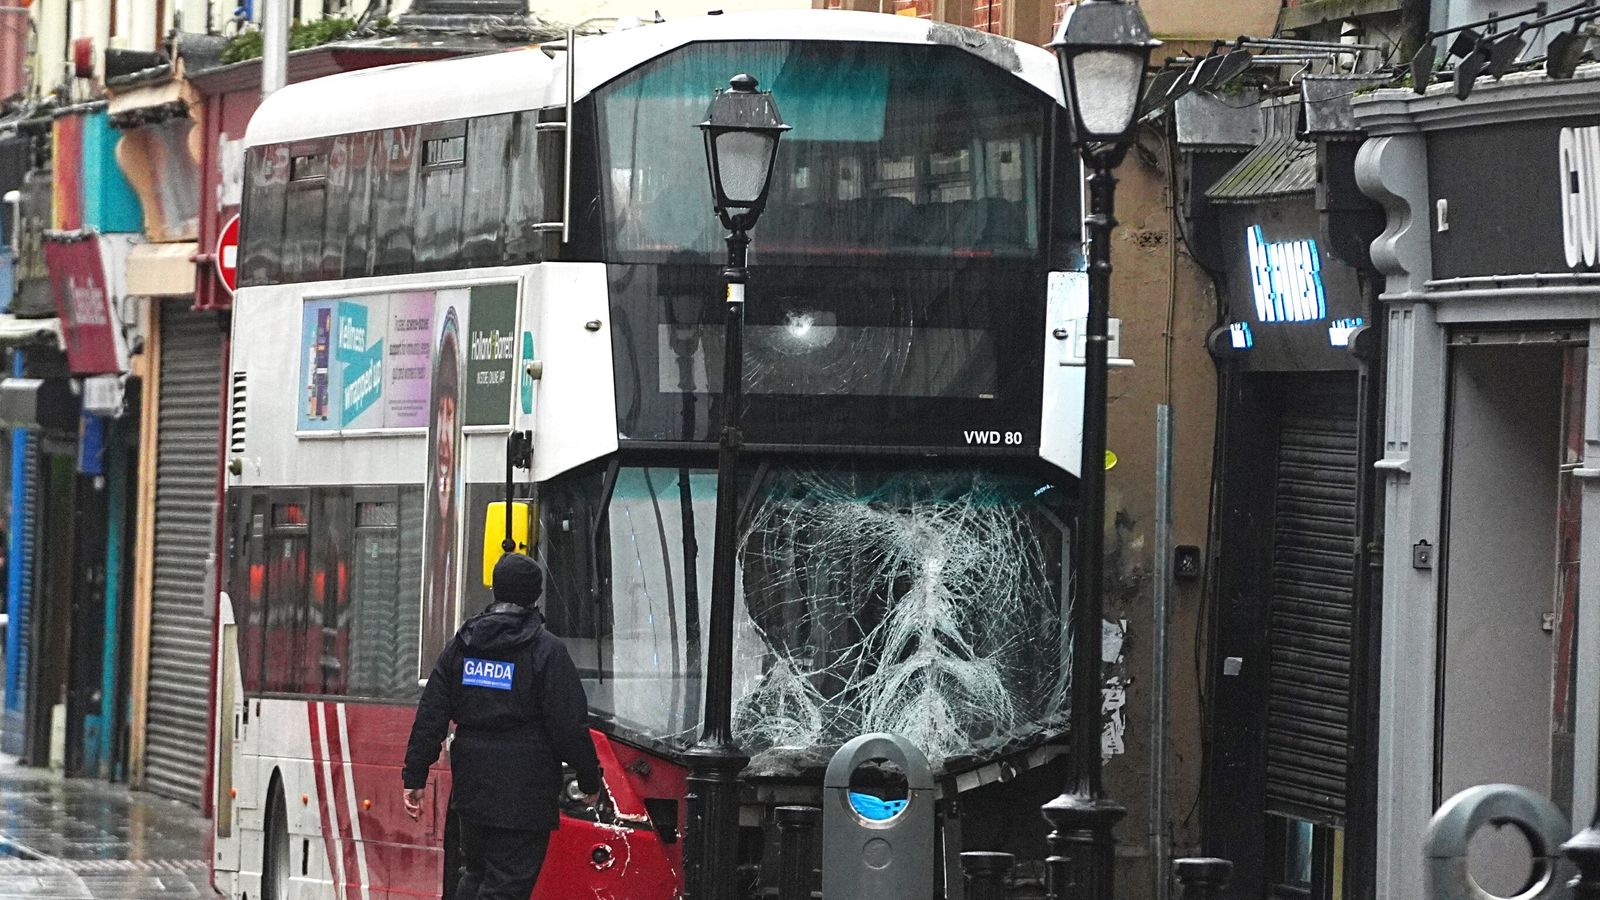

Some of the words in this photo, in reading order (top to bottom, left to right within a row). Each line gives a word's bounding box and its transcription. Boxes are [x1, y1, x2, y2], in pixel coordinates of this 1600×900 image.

[471, 330, 493, 360] Holland
[496, 329, 514, 359] Barrett
[344, 358, 373, 412] wrapped
[963, 430, 1001, 445] VWD
[1004, 431, 1023, 445] 80
[464, 660, 512, 680] GARDA
